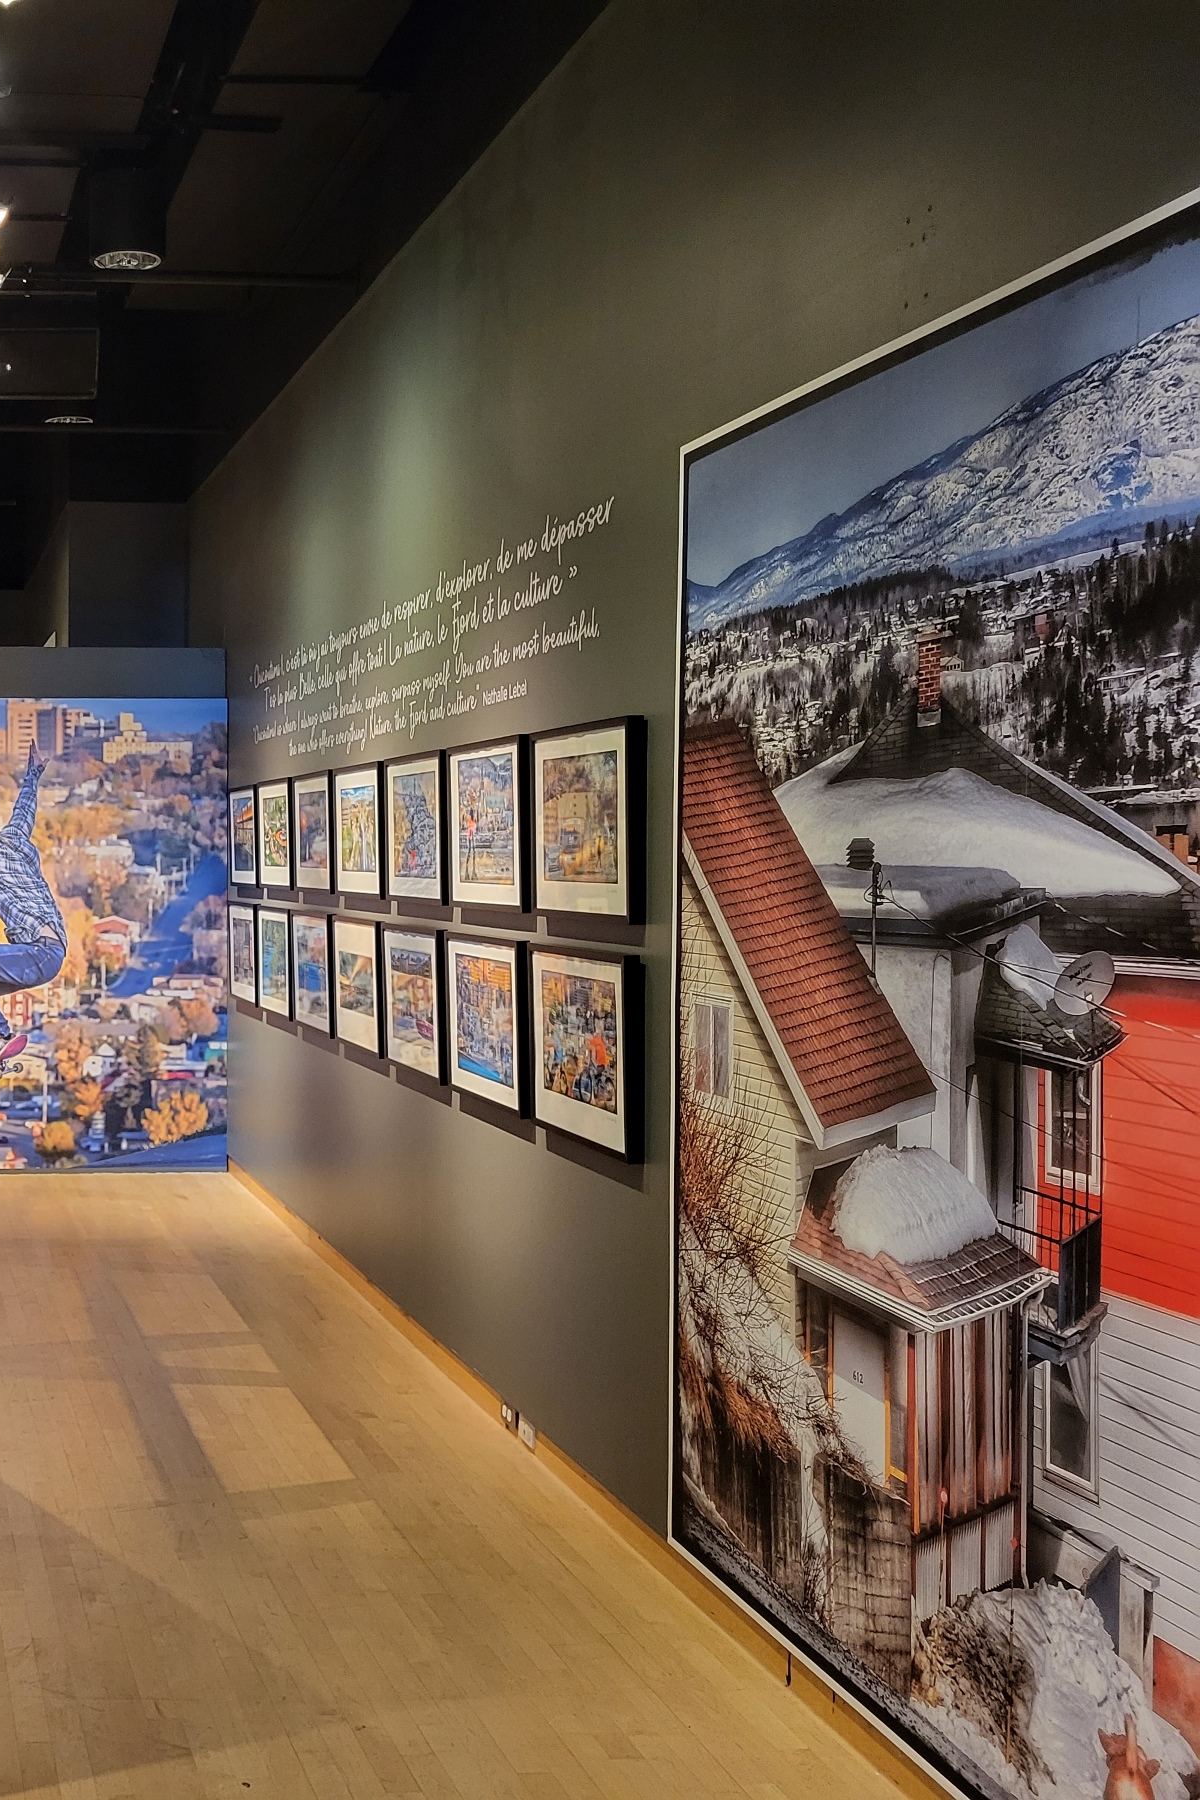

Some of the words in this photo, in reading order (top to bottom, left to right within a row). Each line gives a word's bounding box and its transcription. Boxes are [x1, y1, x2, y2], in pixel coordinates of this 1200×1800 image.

[381, 600, 393, 630] de
[393, 588, 433, 633] respirer,
[496, 538, 513, 574] de
[516, 538, 538, 565] me
[540, 495, 615, 566] dépasser
[317, 663, 334, 688] celle
[348, 649, 367, 687] offre
[388, 632, 402, 666] La
[403, 626, 435, 657] nature,
[437, 614, 448, 645] le
[482, 592, 495, 624] et
[497, 586, 511, 621] la
[513, 571, 563, 612] culture
[339, 692, 364, 719] breathe,
[365, 686, 390, 718] explore,
[391, 679, 422, 711] surpass
[422, 658, 451, 703] myself.
[455, 651, 474, 684] You
[475, 653, 492, 674] are
[492, 640, 511, 669] the
[512, 628, 540, 662] most
[542, 606, 600, 654] beautiful,
[393, 707, 407, 731] the
[429, 693, 446, 721] and
[482, 684, 508, 706] Nathalie
[508, 678, 528, 700] Lebel
[852, 1370, 864, 1384] 612
